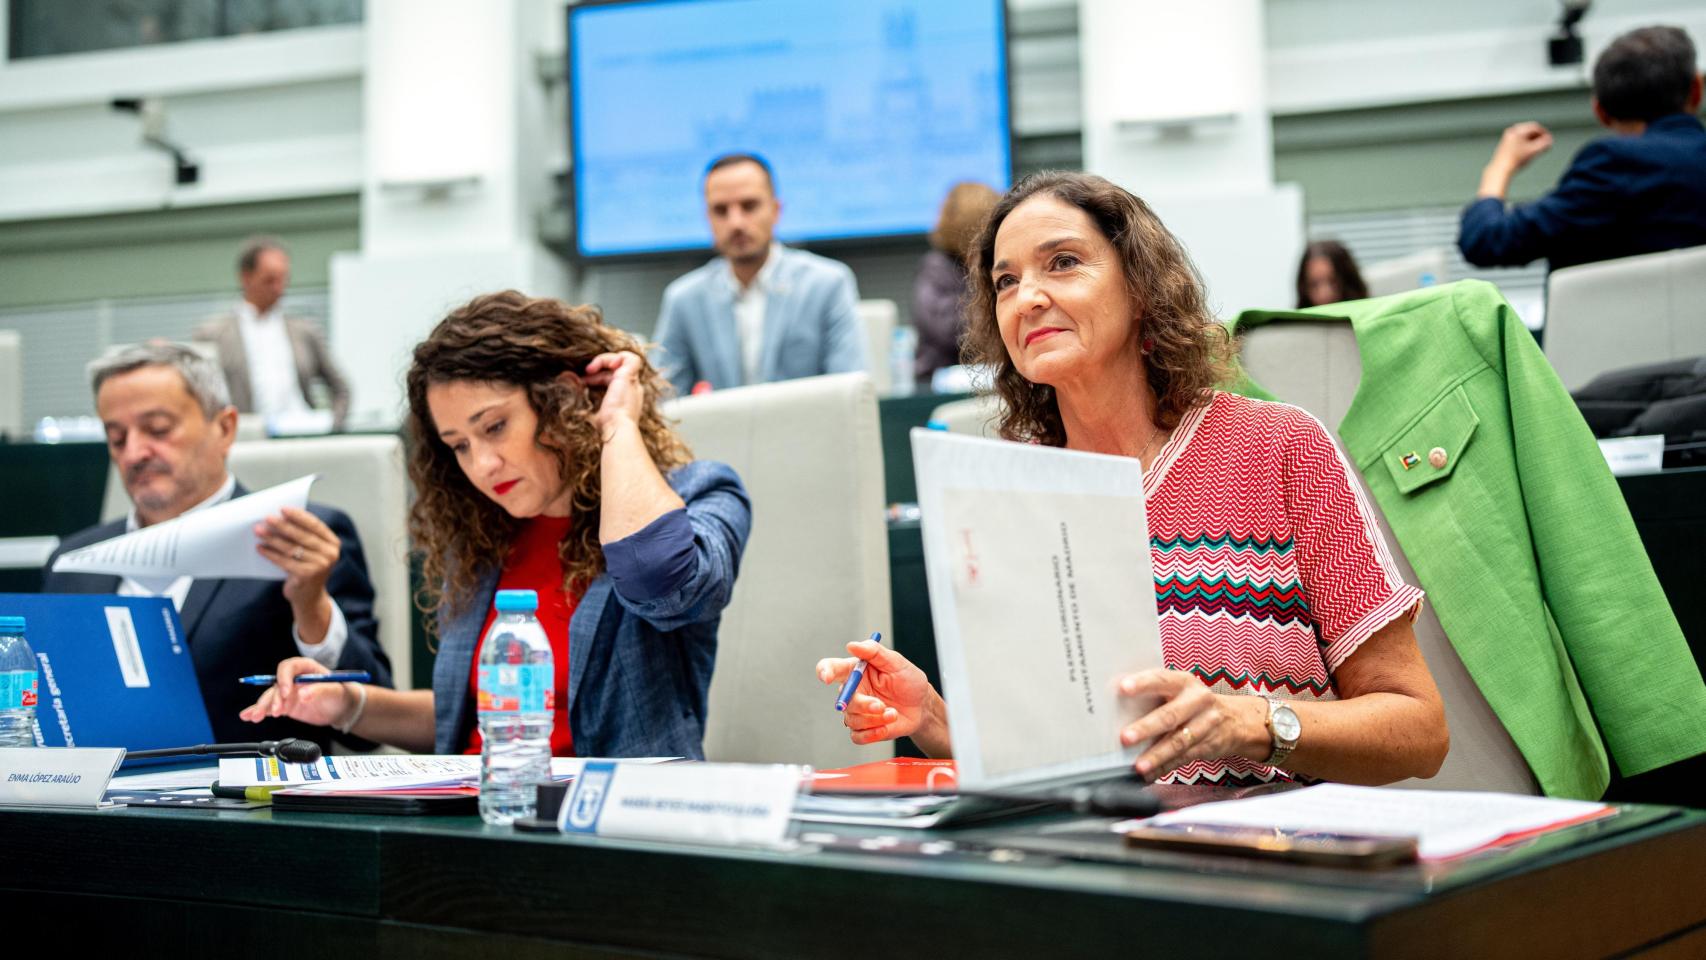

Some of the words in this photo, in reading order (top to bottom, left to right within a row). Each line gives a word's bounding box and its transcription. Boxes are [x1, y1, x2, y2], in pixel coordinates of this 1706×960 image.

[1060, 521, 1074, 578] MADRID
[1051, 554, 1069, 634] ORDINARIO
[1068, 582, 1077, 599] DE
[1063, 637, 1077, 682] PLENO
[1071, 602, 1095, 714] AYUNTAMIENTO
[8, 773, 29, 782] ENMA
[29, 772, 52, 783] LÓPEZ
[51, 772, 82, 784] ARAÚJO
